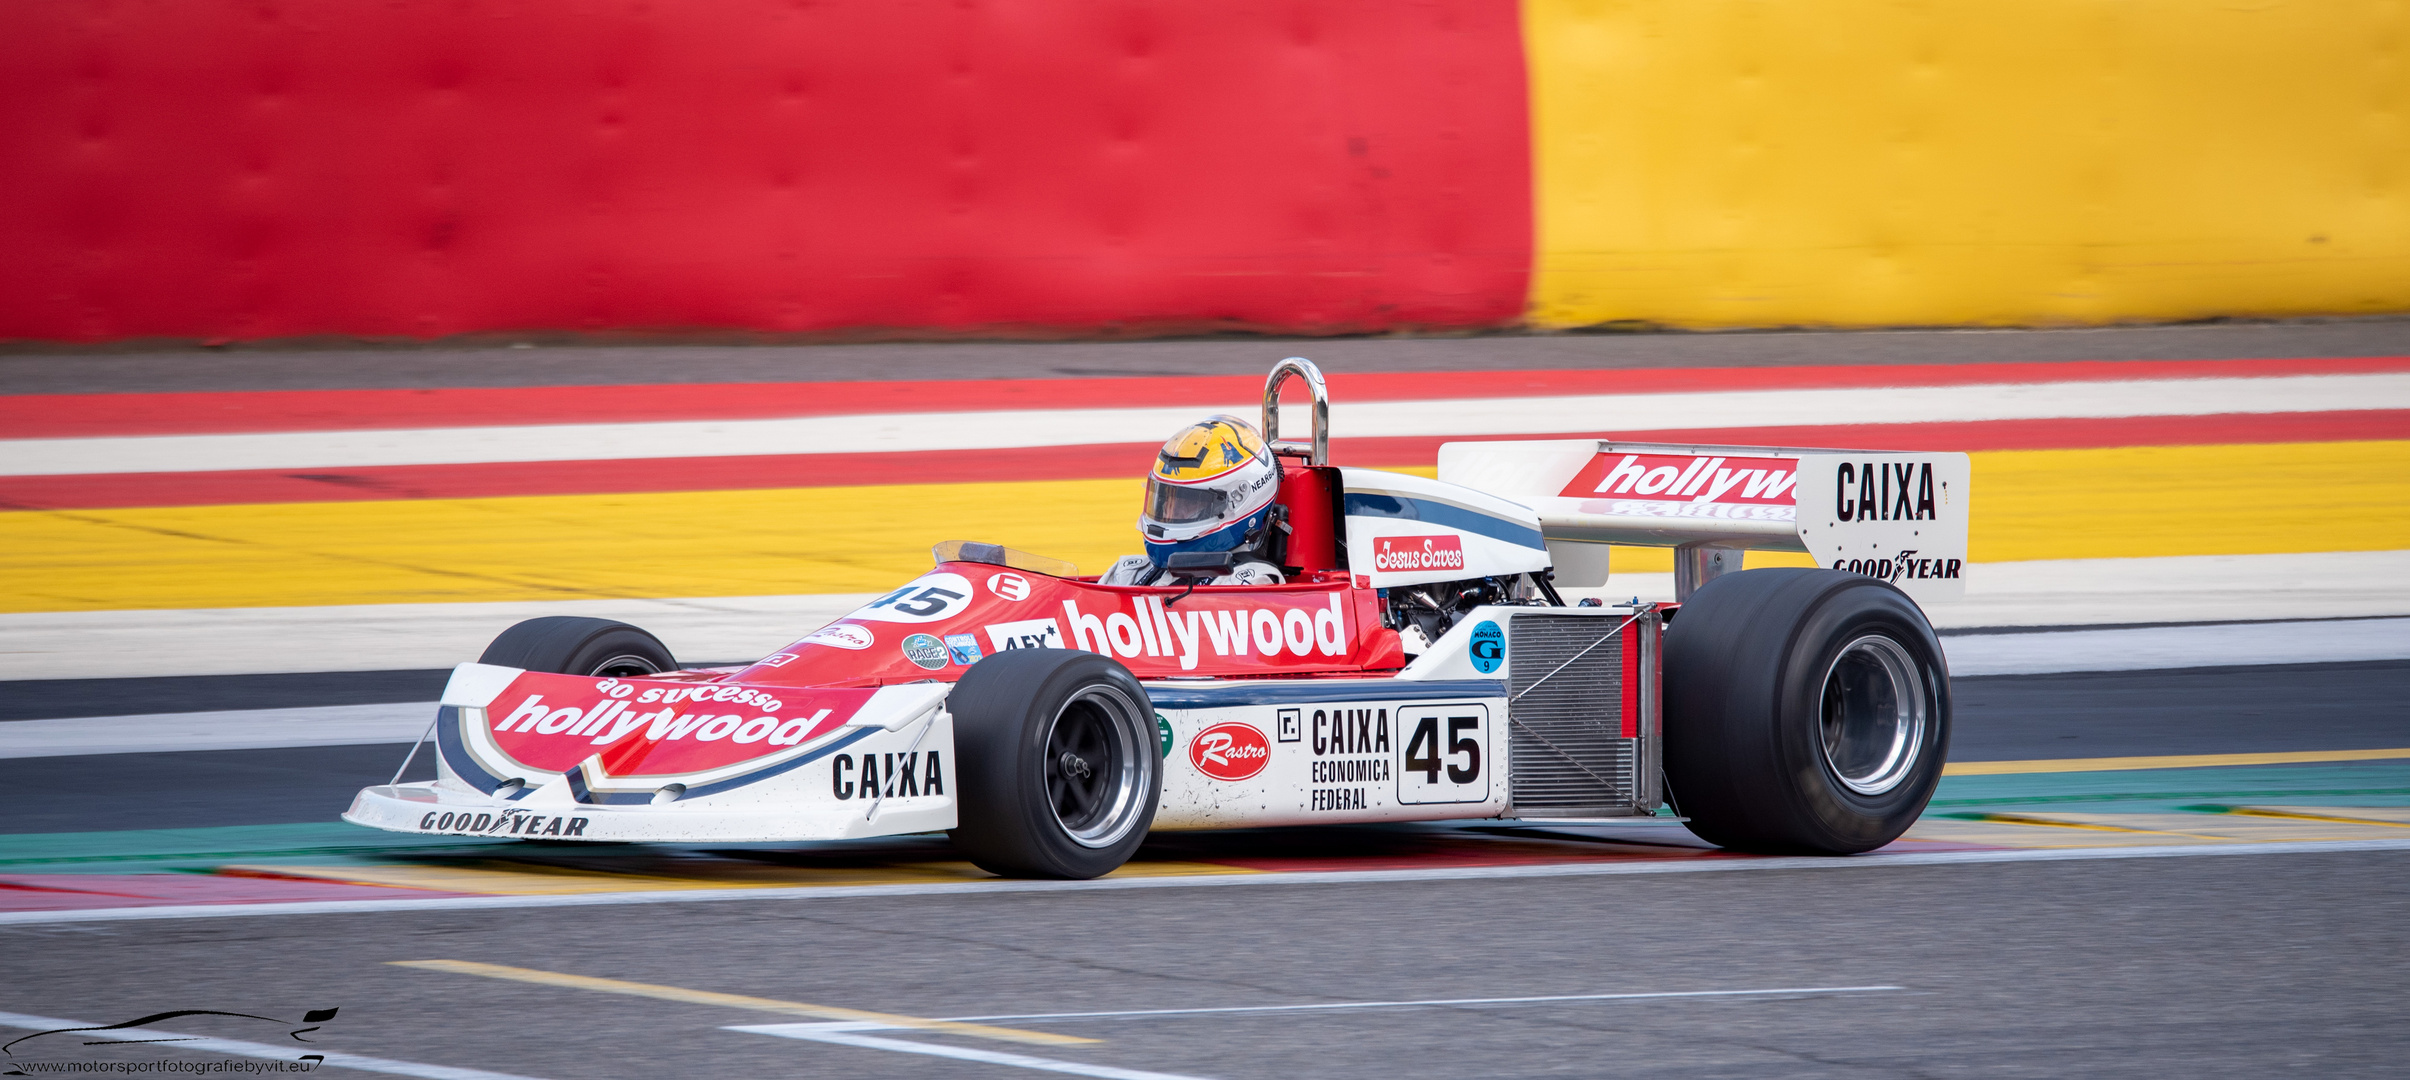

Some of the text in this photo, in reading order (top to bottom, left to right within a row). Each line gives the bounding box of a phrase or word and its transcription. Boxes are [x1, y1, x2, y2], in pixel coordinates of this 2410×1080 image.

[1594, 455, 1797, 503] hollyw
[1837, 462, 1936, 522] CAIXA
[1376, 539, 1462, 569] Jesus Saves
[995, 574, 1023, 600] E
[1062, 592, 1347, 671] hollywood
[1474, 631, 1502, 639] MONACO
[1471, 640, 1503, 660] G
[1483, 660, 1490, 672] 9
[595, 678, 782, 713] ao sucesso
[494, 694, 833, 746] hollywood
[1312, 709, 1390, 756] CAIXA
[1200, 732, 1267, 767] Rastro
[1405, 716, 1481, 784] 45
[833, 750, 944, 800] CAIXA
[1312, 759, 1390, 783] ECONOMICA
[1311, 787, 1368, 811] FEDERAL
